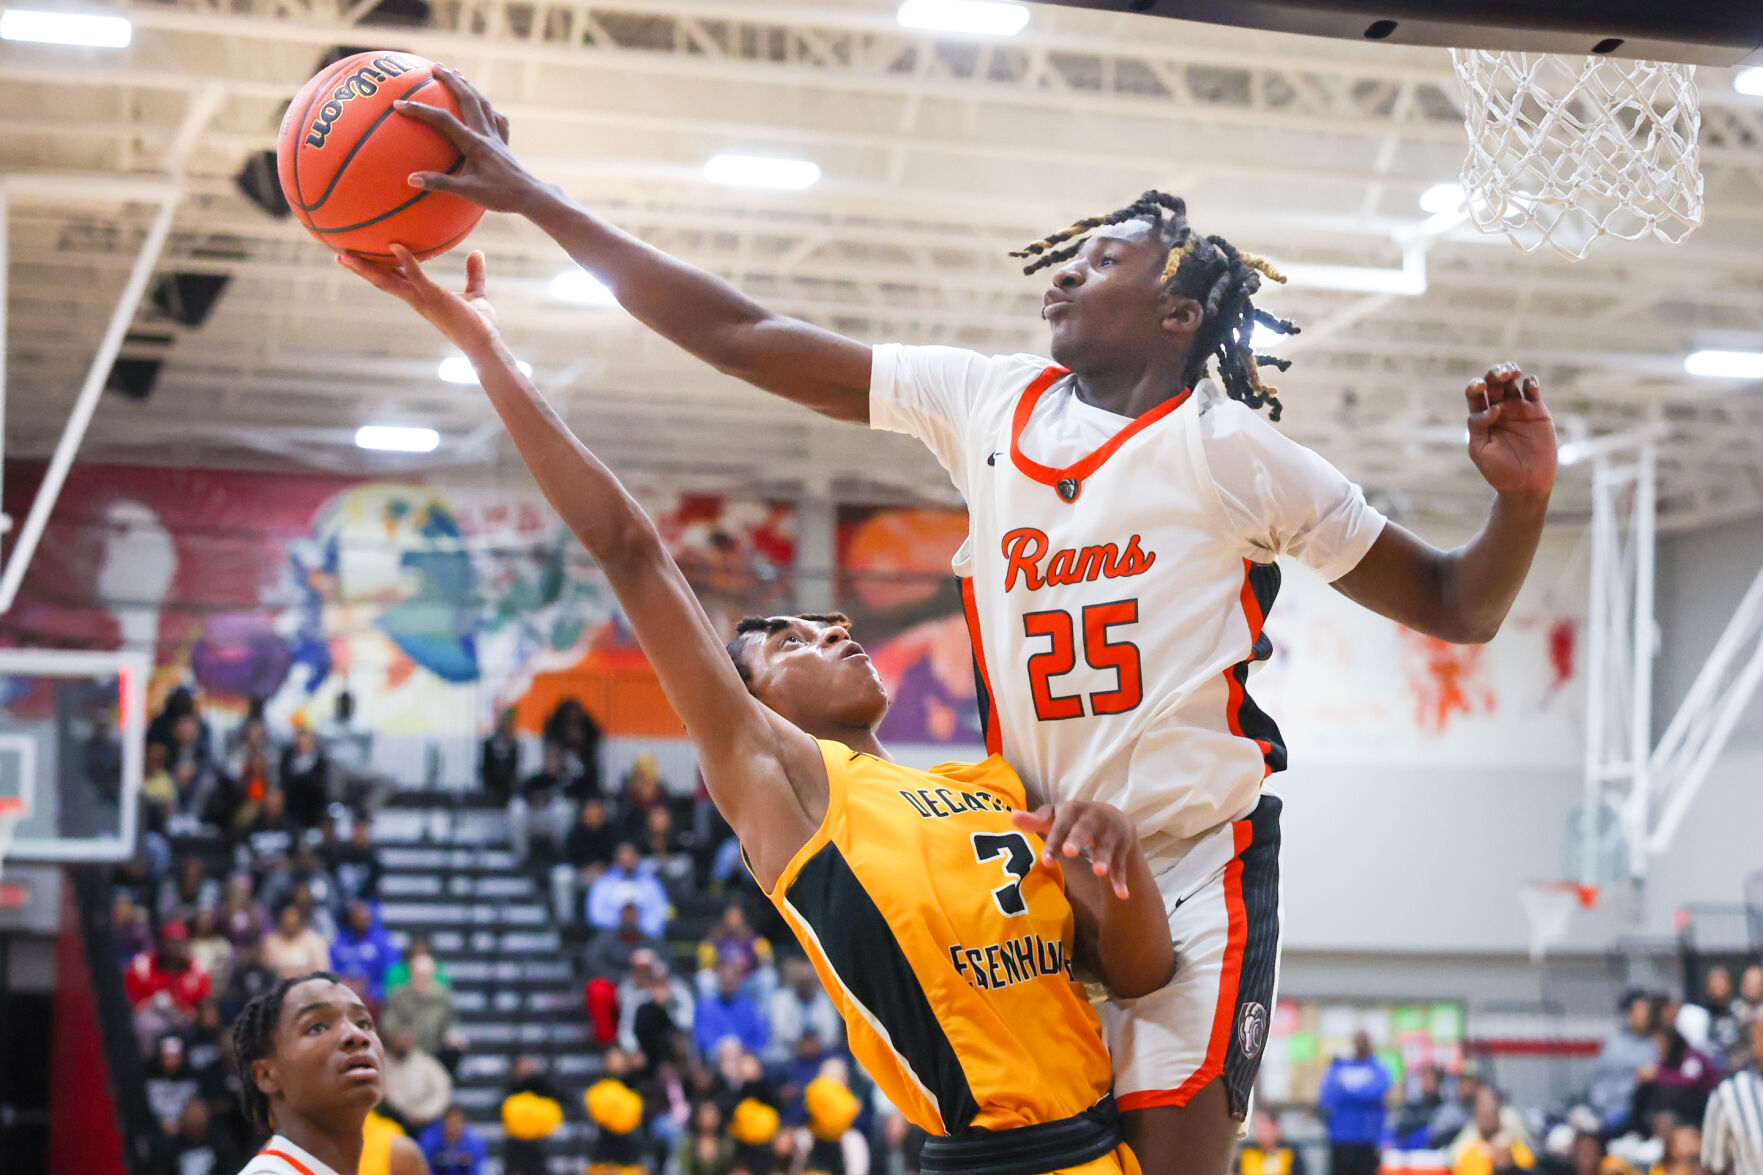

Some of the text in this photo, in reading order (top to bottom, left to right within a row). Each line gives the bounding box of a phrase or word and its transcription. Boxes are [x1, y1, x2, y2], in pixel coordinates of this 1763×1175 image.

[304, 55, 426, 150] Wilson
[1001, 527, 1156, 593] Rams
[1022, 597, 1144, 722] 25
[969, 830, 1036, 918] 3
